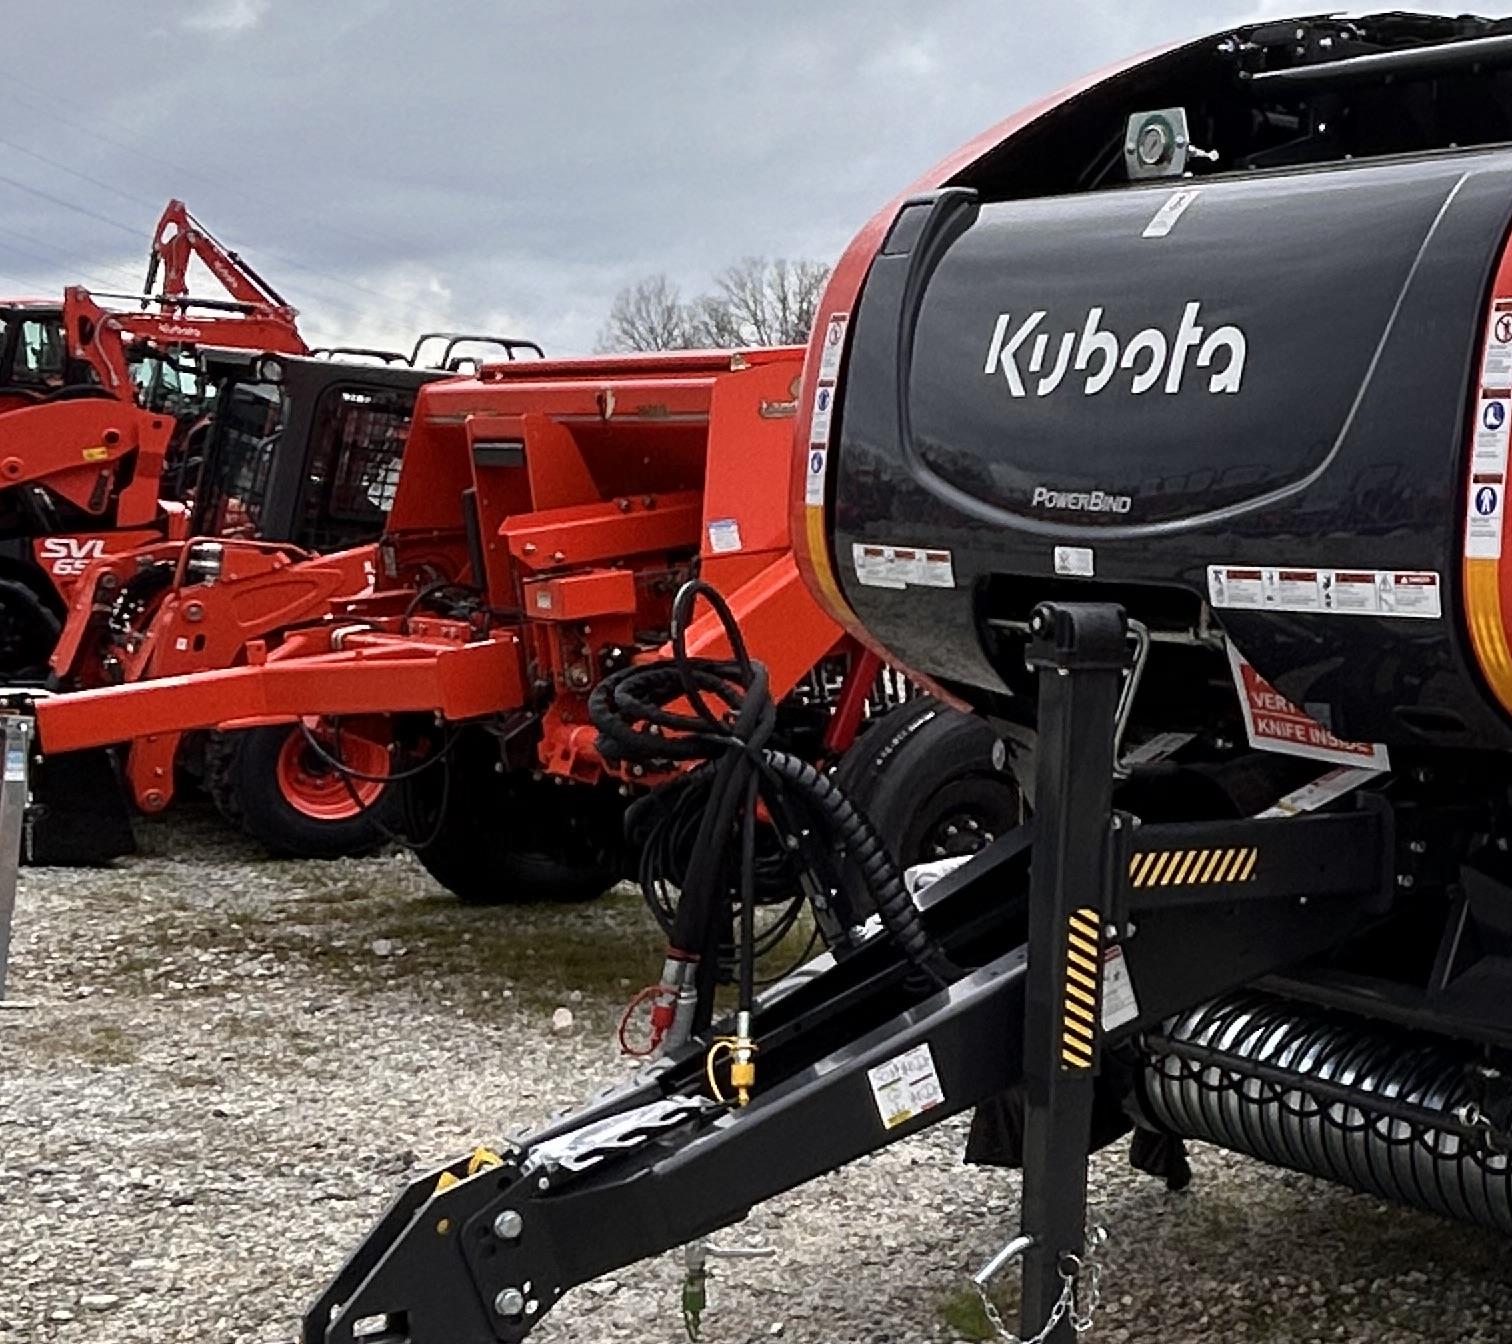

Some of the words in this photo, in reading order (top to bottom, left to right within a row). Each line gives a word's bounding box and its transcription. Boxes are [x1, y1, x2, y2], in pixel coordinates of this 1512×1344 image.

[984, 302, 1247, 397] Kubota
[40, 538, 112, 558] SVL
[1258, 719, 1307, 741] KNIFE
